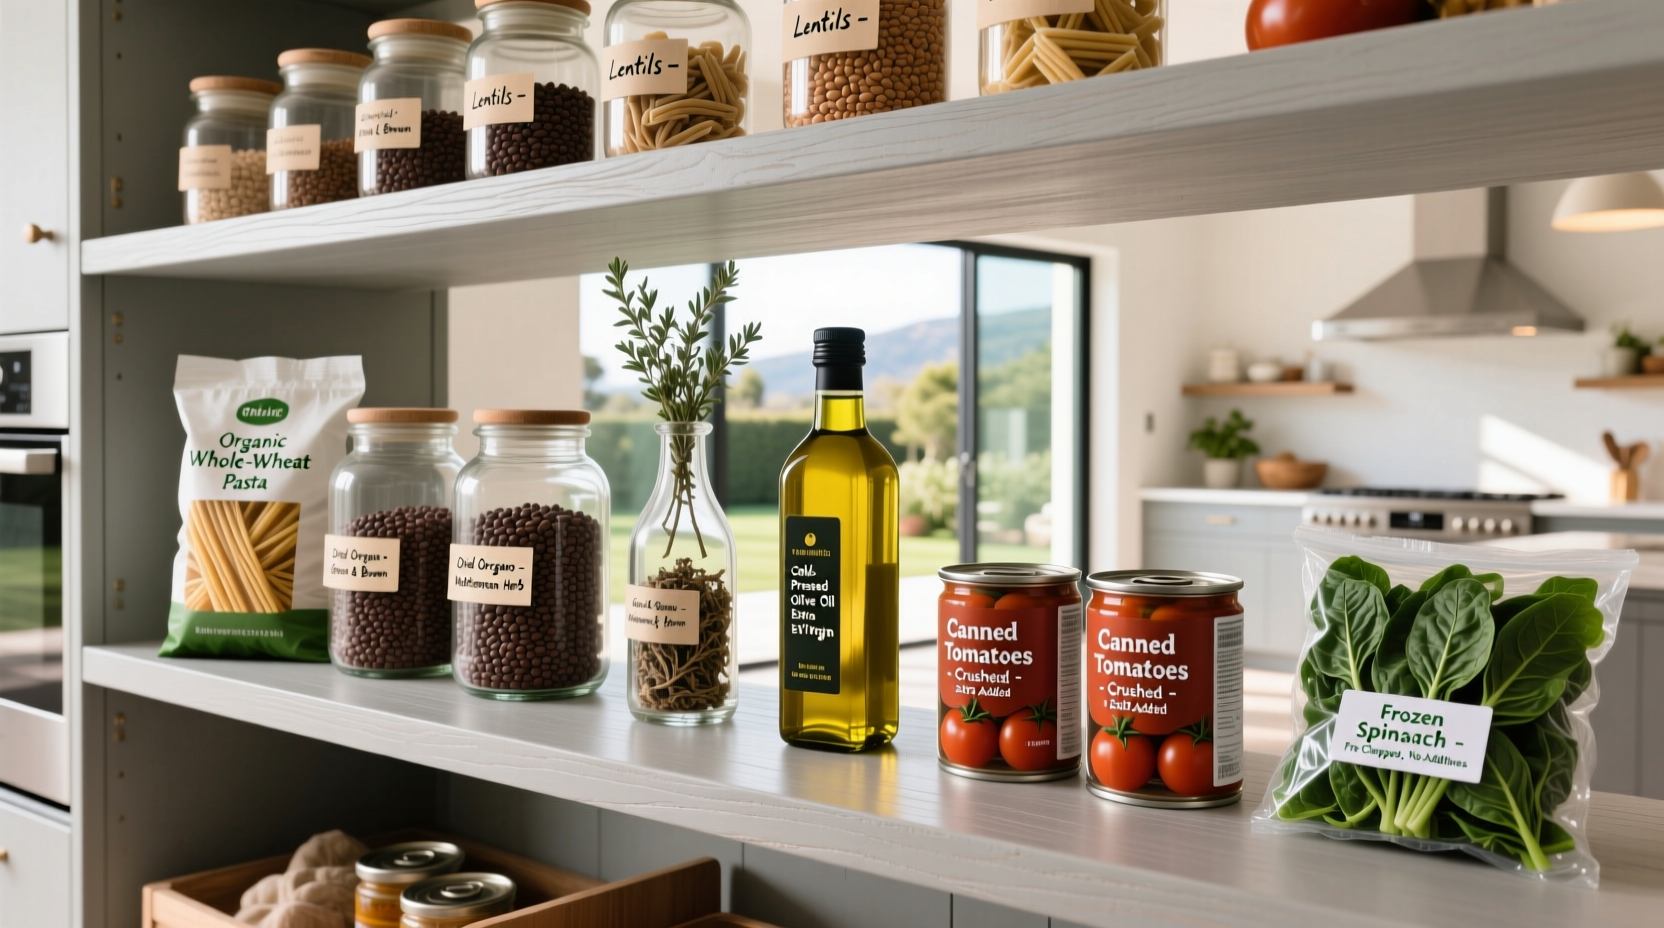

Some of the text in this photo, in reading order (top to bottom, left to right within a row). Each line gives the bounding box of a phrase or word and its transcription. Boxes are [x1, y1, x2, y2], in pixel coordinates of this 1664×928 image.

[793, 7, 851, 38] Lentils
[608, 52, 662, 80] Lentils
[472, 85, 512, 110] Lentils
[219, 432, 288, 453] Organic
[190, 449, 312, 469] Whole-Wheat
[222, 473, 267, 490] Pasta
[946, 617, 1018, 641] Canned
[944, 641, 1033, 665] Tomatoes
[1097, 628, 1176, 655] Canned
[1093, 652, 1189, 680] Tomatoes
[1380, 704, 1444, 727] Frozen
